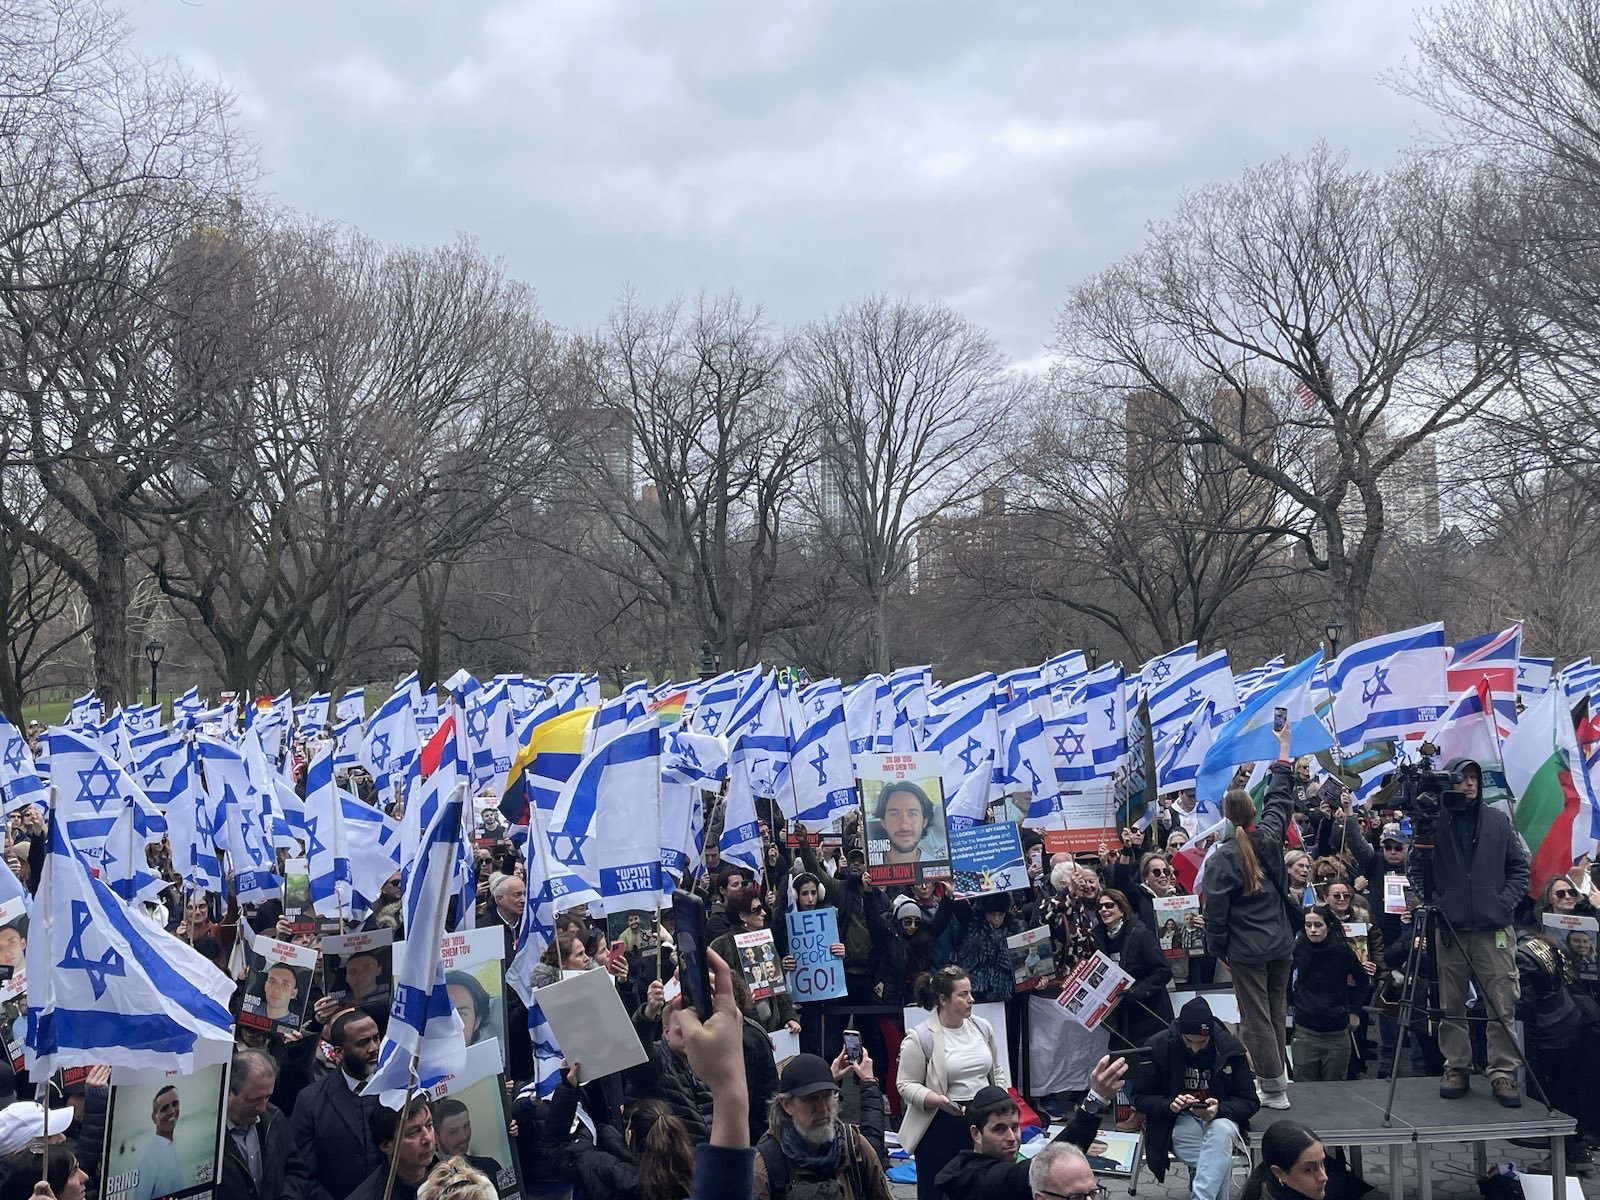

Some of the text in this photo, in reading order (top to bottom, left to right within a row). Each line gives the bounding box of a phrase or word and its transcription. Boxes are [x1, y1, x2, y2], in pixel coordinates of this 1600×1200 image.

[868, 839, 891, 853] BRING
[869, 853, 884, 866] HIM
[616, 865, 650, 880] חופשי
[870, 866, 892, 880] HOME
[617, 877, 652, 892] בארצנו
[286, 907, 301, 916] BRING
[790, 912, 828, 936] LET
[791, 934, 828, 950] OUR
[441, 945, 470, 958] SHEM TOV
[795, 967, 835, 994] GO!
[1062, 960, 1086, 989] KIDNAPPED
[243, 993, 261, 1007] BRING
[242, 1003, 254, 1014] HIM
[64, 1066, 84, 1082] HOME
[107, 1169, 140, 1195] BRING
